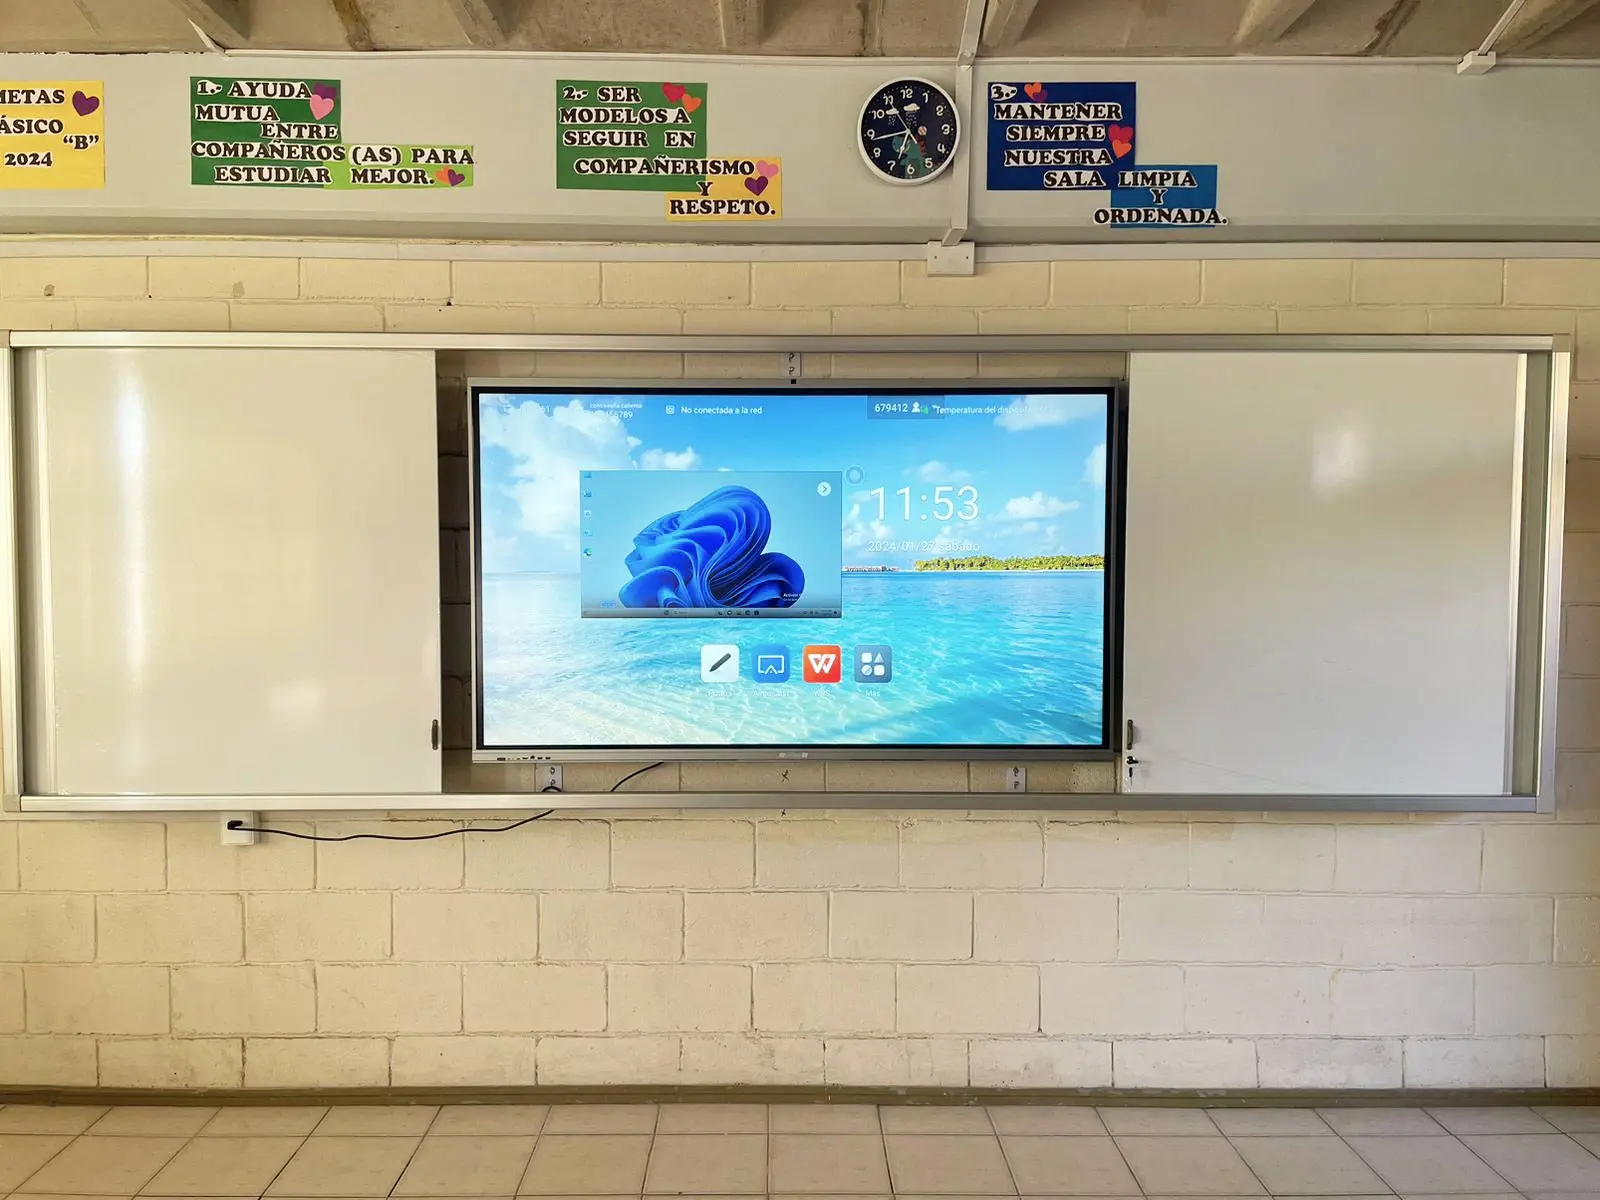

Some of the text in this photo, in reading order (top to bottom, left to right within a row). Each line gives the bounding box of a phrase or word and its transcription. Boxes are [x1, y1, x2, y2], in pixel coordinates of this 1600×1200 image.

[227, 82, 313, 99] AYUDA
[598, 87, 641, 102] SER
[900, 88, 913, 100] 12
[922, 92, 929, 103] 1
[196, 105, 279, 121] MUTUA
[560, 108, 690, 124] MODELOS A
[871, 109, 885, 120] 10
[935, 105, 944, 117] 2
[995, 104, 1122, 120] MANTENER
[261, 123, 338, 140] ENTRE
[866, 128, 876, 140] 9
[941, 124, 950, 135] 3
[1007, 125, 1105, 141] SIEMPRE
[564, 131, 696, 147] SEGUIR EN
[191, 139, 474, 165] COMPAÑEROS (AS) PARA
[873, 147, 882, 158] 8
[937, 143, 946, 154] 4
[5, 152, 53, 167] 2024
[575, 155, 755, 175] COMPAÑERISMO
[887, 160, 896, 171] 7
[924, 157, 933, 169] 5
[1005, 150, 1113, 166] NUESTRA
[215, 167, 435, 185] ESTUDIAR MEJOR.
[906, 164, 915, 175] 6
[1044, 171, 1197, 187] SALA LIMPIA
[698, 181, 713, 196] Y
[1150, 188, 1168, 204] Y
[669, 200, 776, 215] RESPETO.
[1094, 208, 1227, 224] ORDENADA.
[680, 406, 691, 415] No
[692, 406, 732, 415] conectada
[741, 406, 749, 415] la
[750, 406, 763, 415] red
[874, 403, 909, 413] 679412
[935, 406, 983, 416] Temperatura
[985, 405, 996, 415] del
[870, 485, 980, 521] 11:53
